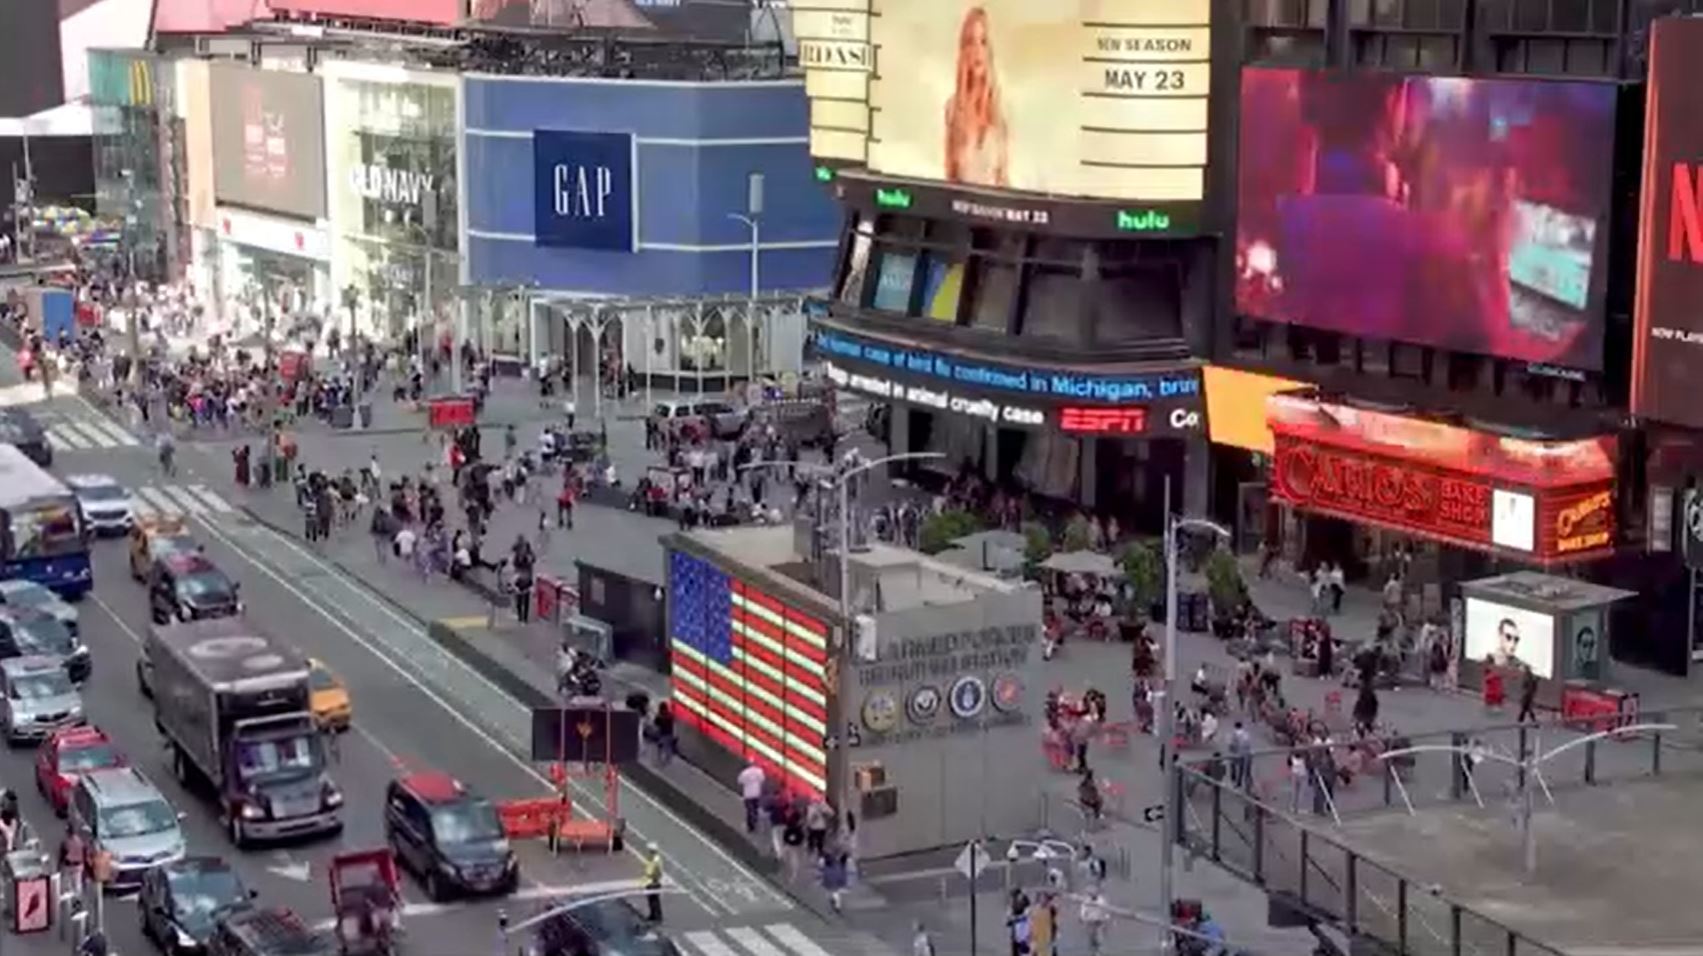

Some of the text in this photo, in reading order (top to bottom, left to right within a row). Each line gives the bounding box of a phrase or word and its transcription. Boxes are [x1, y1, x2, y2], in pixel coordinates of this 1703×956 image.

[1125, 38, 1190, 51] SEASON
[1105, 69, 1185, 90] MAY 23
[383, 167, 434, 205] NAVY
[555, 164, 611, 216] GAP
[1117, 209, 1170, 230] hulu
[954, 364, 1027, 391] confirmed
[1029, 374, 1048, 391] in
[1052, 375, 1153, 402] Michigan,
[950, 396, 1000, 423] cruelty
[1002, 405, 1045, 425] case
[1060, 407, 1144, 432] ESPN
